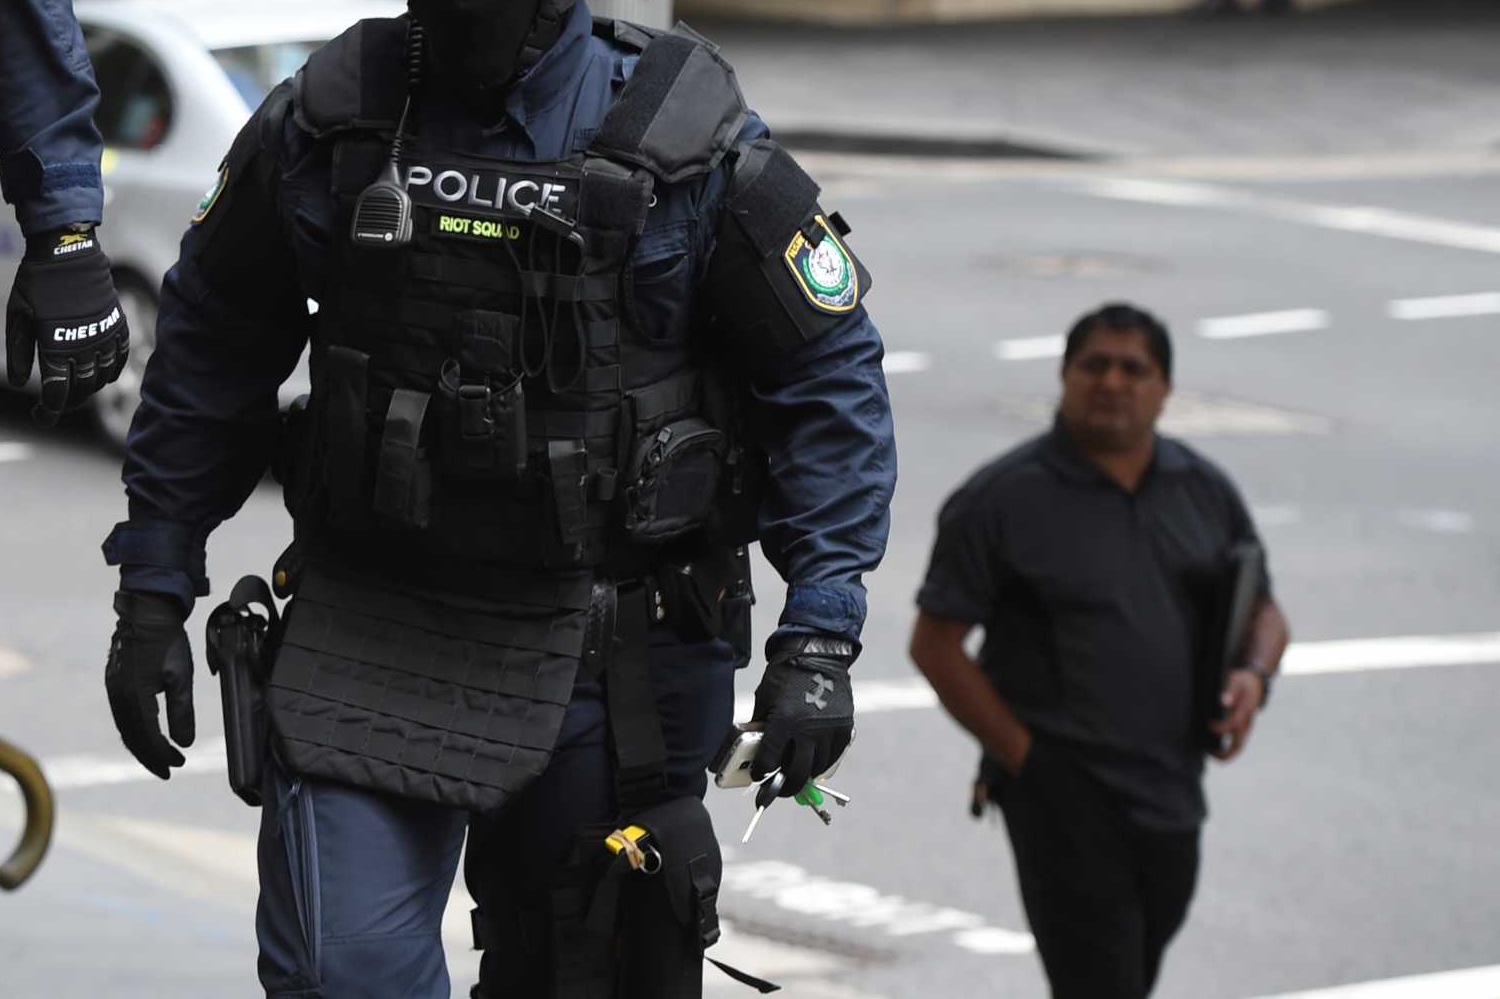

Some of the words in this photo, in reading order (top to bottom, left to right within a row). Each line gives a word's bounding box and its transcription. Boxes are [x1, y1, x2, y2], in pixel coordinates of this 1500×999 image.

[406, 166, 566, 217] POLICE
[439, 216, 471, 234] RIOT
[53, 239, 93, 255] CHEETAH
[53, 307, 120, 341] CHEETAH
